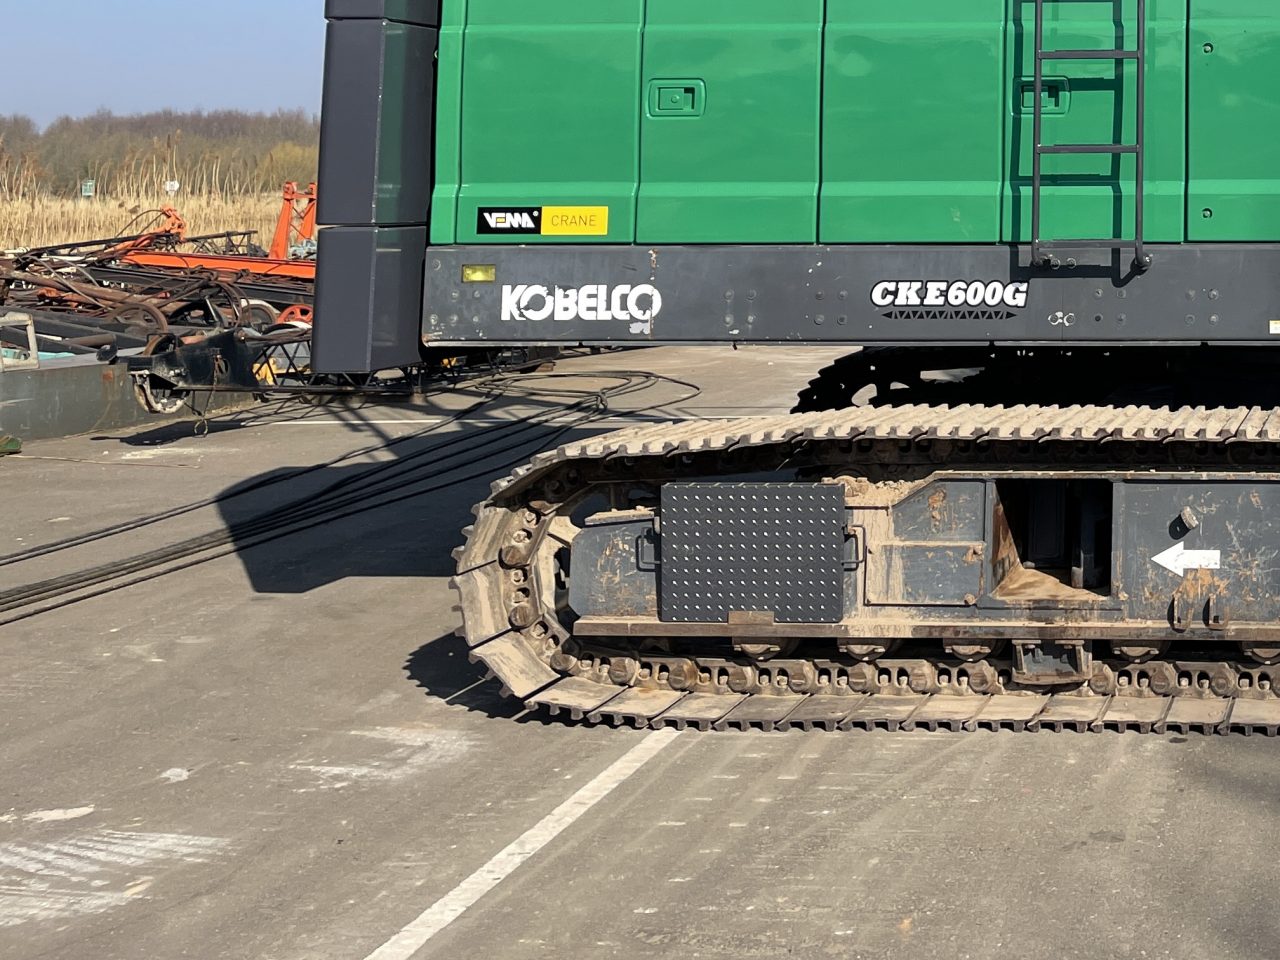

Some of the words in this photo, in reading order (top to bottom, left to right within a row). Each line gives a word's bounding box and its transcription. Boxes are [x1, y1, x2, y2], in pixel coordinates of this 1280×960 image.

[551, 215, 597, 226] CRANE
[501, 284, 662, 321] KOBELCO
[871, 281, 1028, 307] CKE600G
